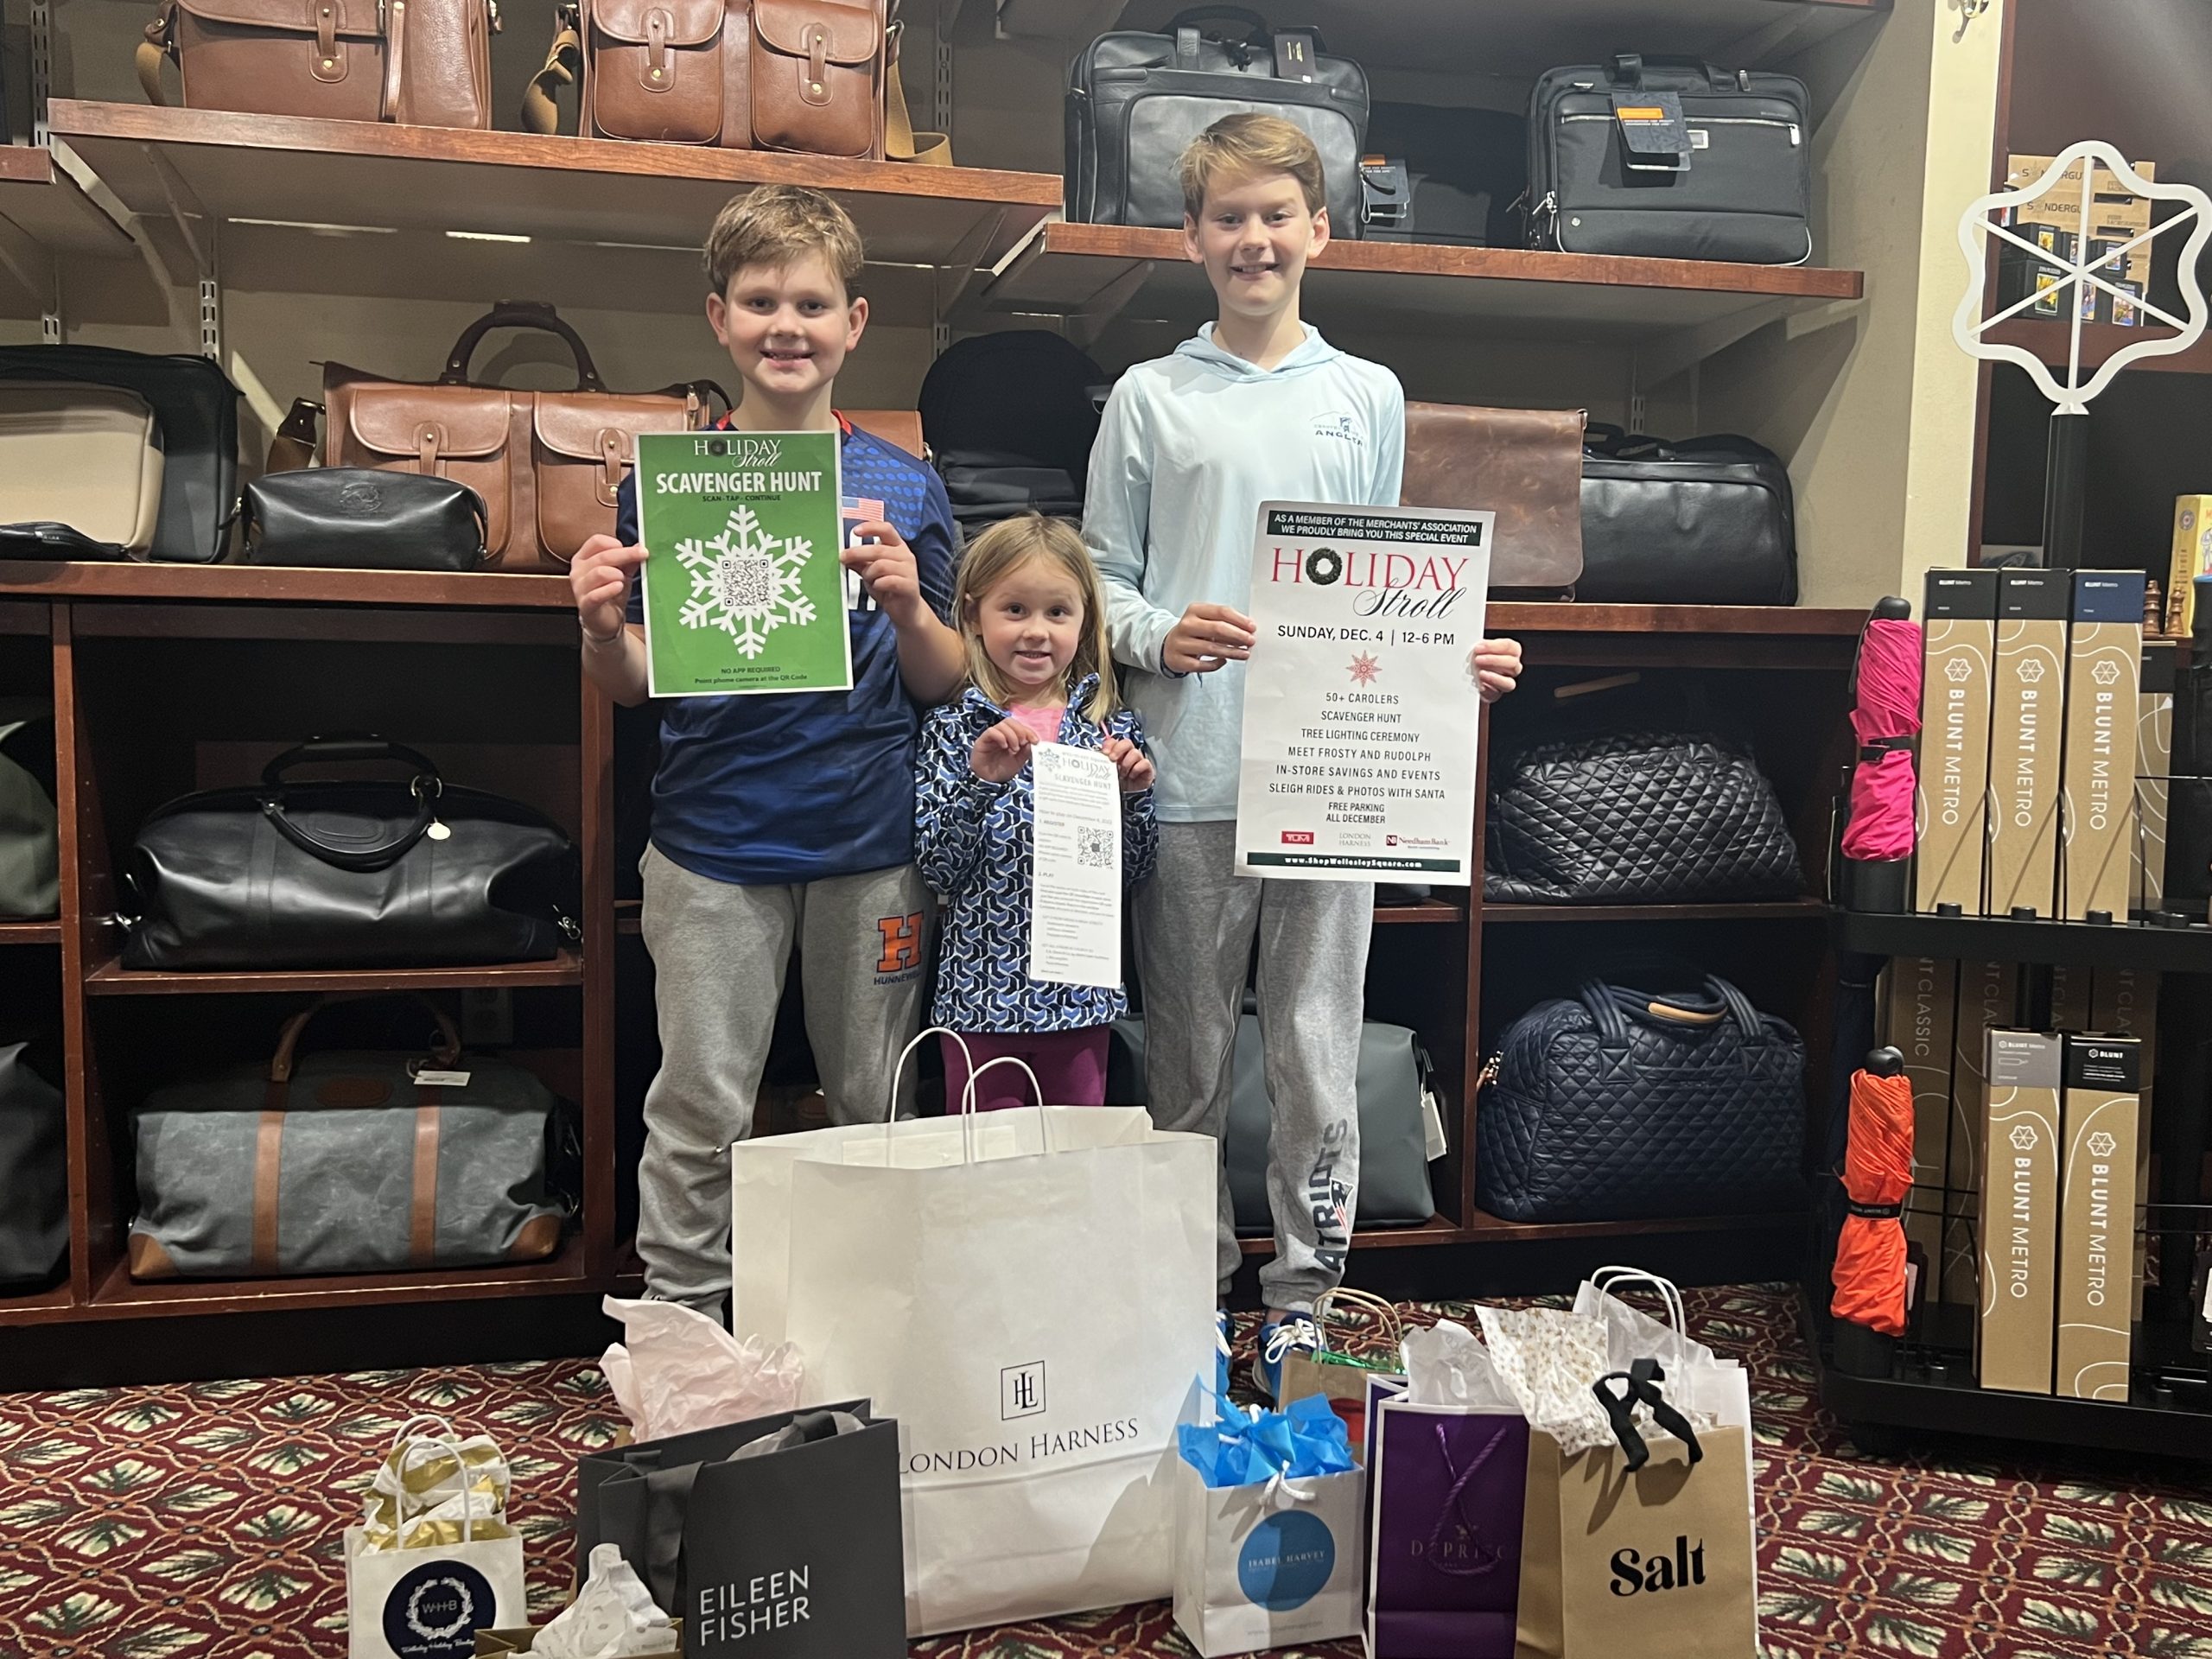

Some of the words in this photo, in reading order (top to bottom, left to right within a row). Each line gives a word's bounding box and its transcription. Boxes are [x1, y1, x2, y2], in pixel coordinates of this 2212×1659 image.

[694, 439, 781, 456] HOLIDAY
[732, 452, 782, 468] Stroll
[656, 472, 766, 493] SCAVENGER
[770, 471, 822, 492] HUNT
[1274, 513, 1287, 523] AS
[1287, 514, 1295, 524] A
[1296, 515, 1332, 526] MEMBER
[1334, 518, 1346, 527] OF
[1348, 518, 1364, 528] THE
[1421, 522, 1477, 534] ASSOCIATION
[1281, 524, 1296, 534] WE
[1297, 525, 1336, 537] PROUDLY
[1338, 527, 1364, 538] BRING
[1365, 529, 1382, 539] YOU
[1385, 531, 1403, 540] THIS
[1405, 531, 1440, 543] SPECIAL
[1440, 533, 1468, 543] EVENT
[1271, 546, 1469, 591] HOLIDAY
[1352, 577, 1467, 620] Stroll
[1277, 625, 1336, 642] SUNDAY,
[1340, 628, 1371, 642] DEC.
[1376, 631, 1383, 641] 4
[1433, 633, 1455, 645] PM
[1321, 711, 1375, 722] SCAVENGER
[1376, 713, 1402, 723] HUNT
[1325, 692, 1345, 702] 50+
[1348, 693, 1400, 704] CAROLERS
[1301, 728, 1324, 739] TREE
[1326, 730, 1368, 741] LIGHTING
[1370, 731, 1420, 743] CEREMONY
[1945, 689, 1965, 752] BLUNT
[2018, 690, 2037, 753] BLUNT
[2092, 692, 2113, 755] BLUNT
[1276, 765, 1325, 777] IN-STORE
[1328, 766, 1373, 778] SAVINGS
[1376, 769, 1398, 779] AND
[1402, 770, 1440, 780] EVENTS
[1288, 747, 1315, 758] MEET
[1319, 747, 1357, 759] FROSTY
[1359, 749, 1381, 760] AND
[1383, 750, 1431, 762] RUDOLPH
[1094, 781, 1111, 790] HUNT
[1268, 783, 1304, 794] SLEIGH
[1306, 785, 1335, 795] RIDES
[1337, 786, 1344, 795] &
[1347, 786, 1385, 797] PHOTOS
[1388, 787, 1413, 798] WITH
[1414, 789, 1446, 799] SANTA
[1942, 756, 1961, 825] METRO
[2014, 758, 2034, 827] METRO
[2089, 760, 2108, 830] METRO
[1325, 813, 1341, 823] ALL
[1342, 814, 1386, 824] DECEMBER
[1328, 802, 1348, 811] FREE
[1350, 803, 1385, 813] PARKING
[877, 911, 924, 973] H
[1914, 979, 1934, 1057] CLASSIC
[1309, 1118, 1349, 1274] ATRIOTS
[2013, 1157, 2031, 1223] BLUNT
[2090, 1164, 2110, 1228] BLUNT
[2009, 1227, 2030, 1299] METRO
[2087, 1233, 2107, 1306] METRO
[1032, 1417, 1138, 1459] HARNESS
[1249, 1556, 1281, 1567] ISABEL
[1287, 1550, 1325, 1562] HARVEY
[1611, 1535, 1706, 1596] Salt
[700, 1566, 809, 1615] EILEEN
[701, 1597, 810, 1646] FISHER
